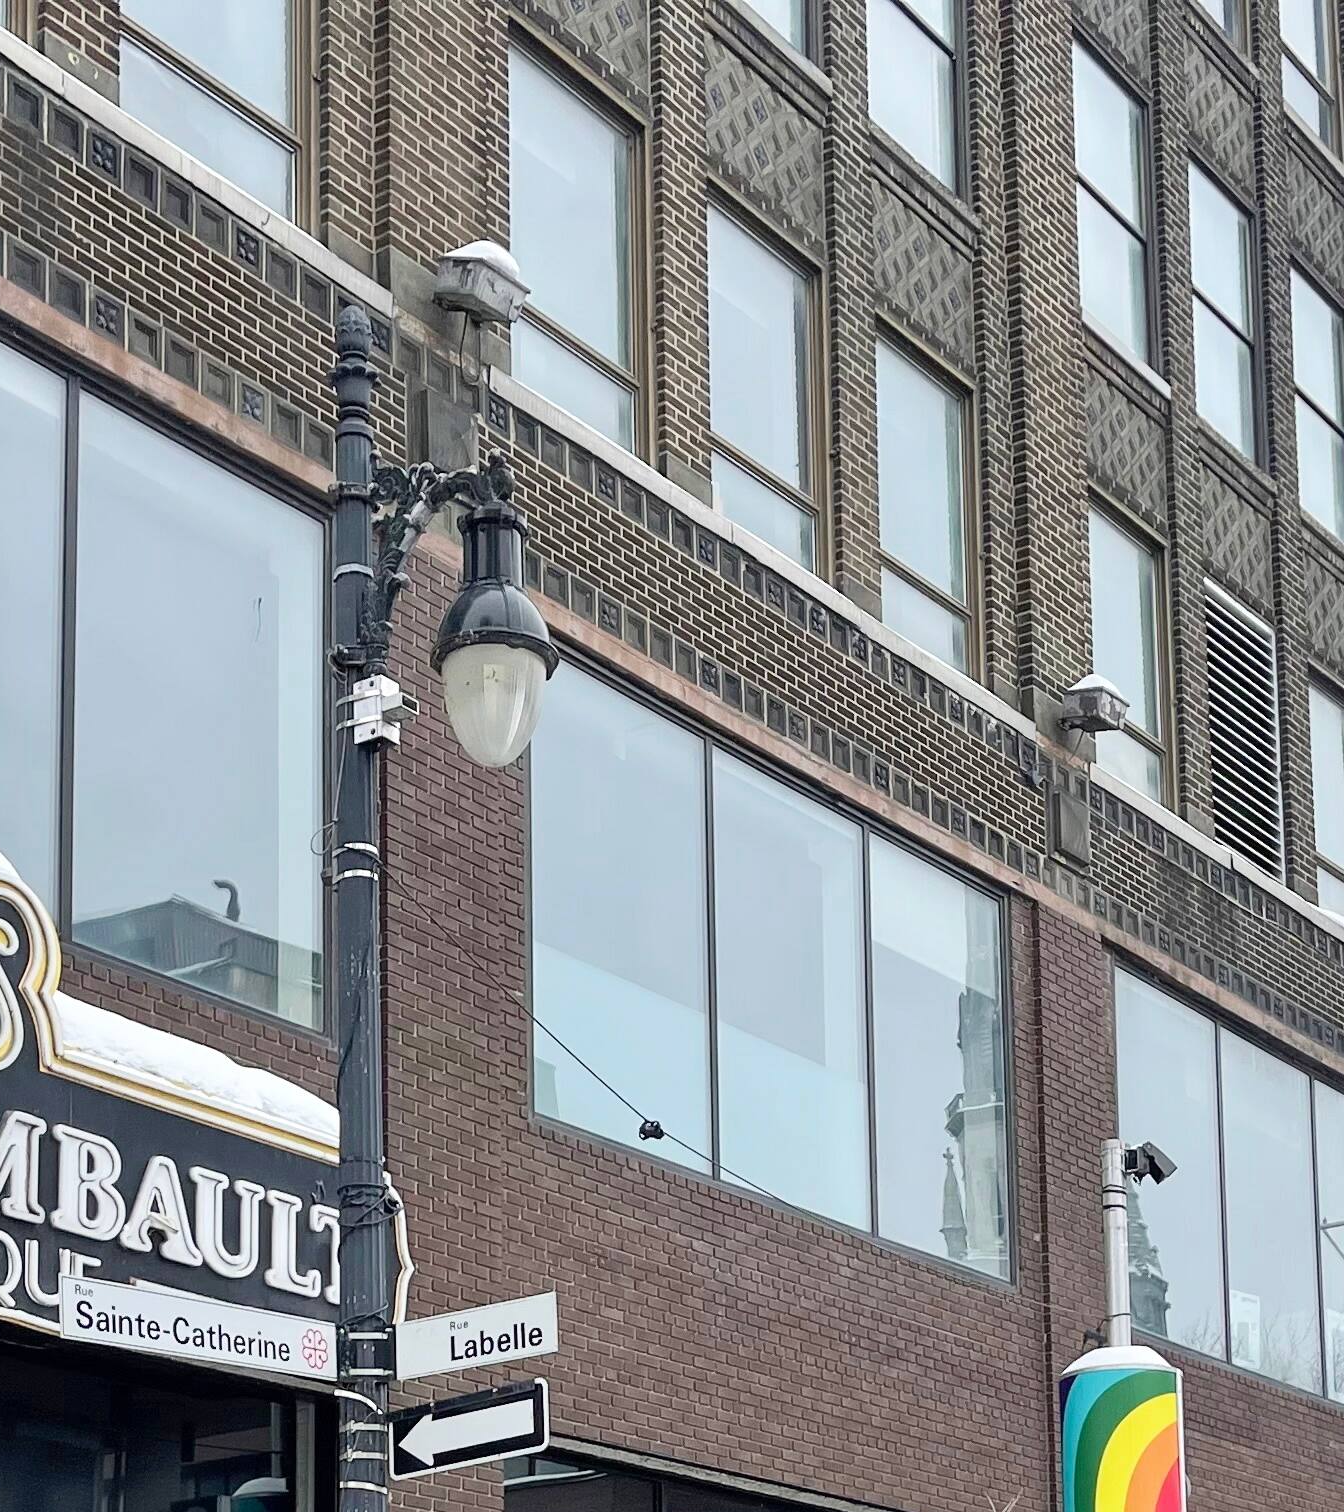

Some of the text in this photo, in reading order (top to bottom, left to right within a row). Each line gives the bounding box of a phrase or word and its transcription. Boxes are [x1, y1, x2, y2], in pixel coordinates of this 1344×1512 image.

[74, 1284, 95, 1298] Rue
[75, 1300, 291, 1363] Sainte-Catherine
[449, 1319, 469, 1332] Rue
[450, 1321, 544, 1363] Labelle
